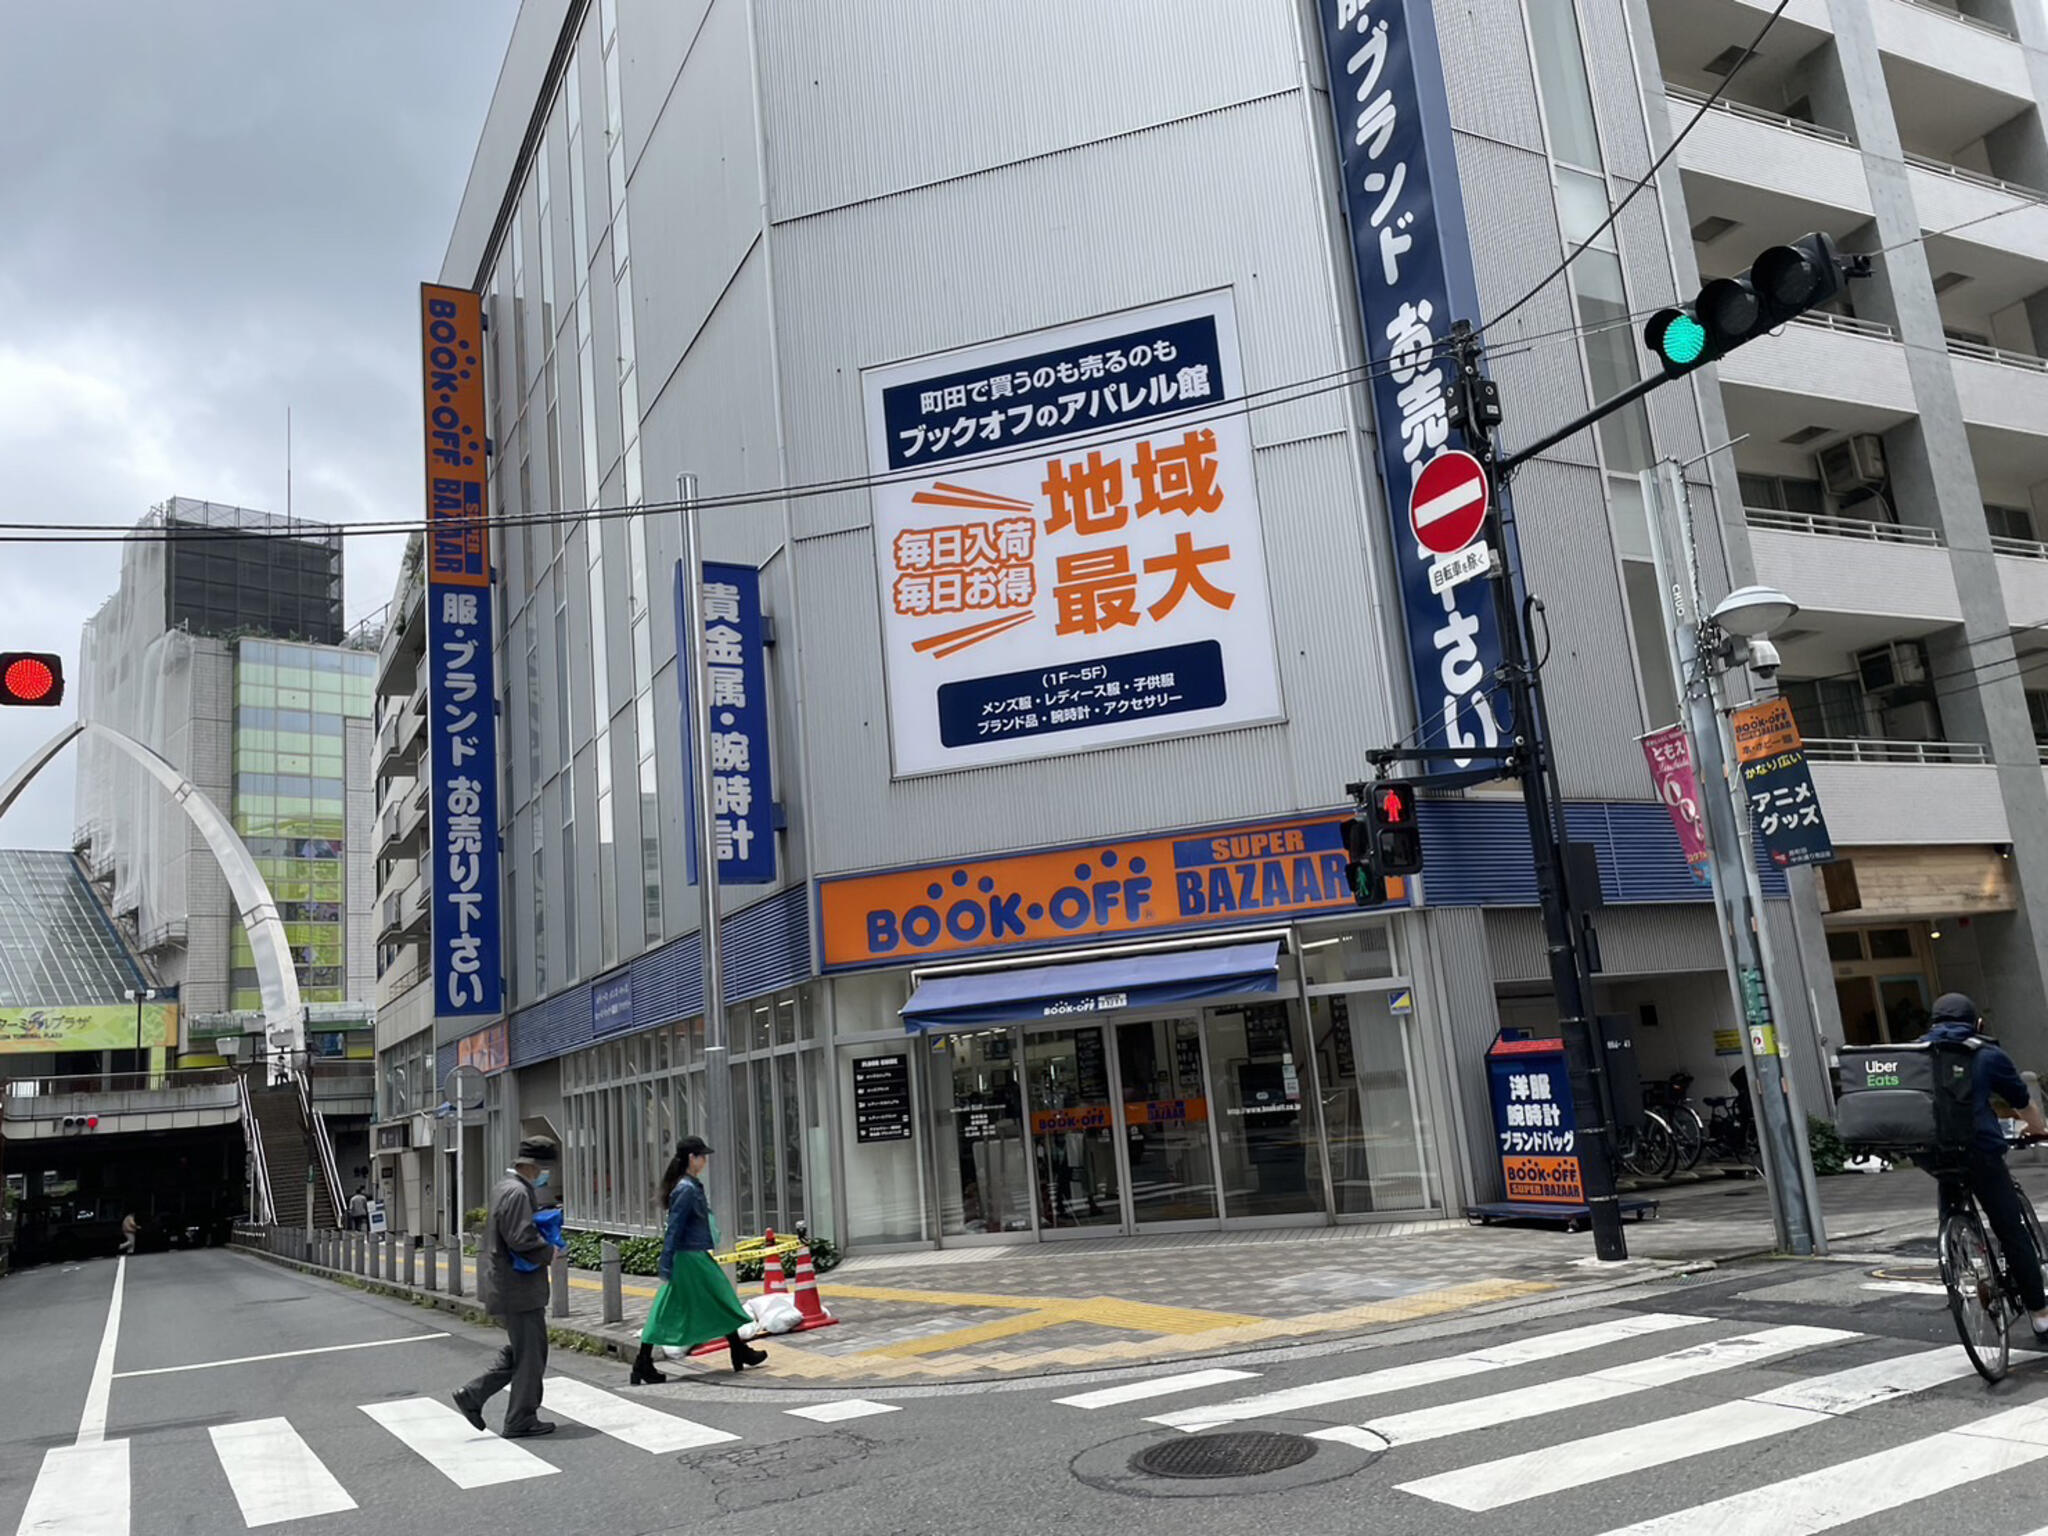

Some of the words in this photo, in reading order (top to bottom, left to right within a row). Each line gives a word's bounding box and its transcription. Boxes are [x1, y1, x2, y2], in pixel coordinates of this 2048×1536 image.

[920, 340, 1177, 415] 町田で買うのも売るのも
[899, 364, 1211, 458] ブックオフのアパレル館
[1041, 427, 1224, 536] 地域
[894, 518, 1036, 572] 毎日入荷
[1386, 298, 1498, 768] お売さい
[894, 563, 1036, 617] 毎日お得
[1053, 531, 1236, 637] 最大
[1434, 551, 1485, 587] 自転車を除く
[1672, 583, 1685, 617] CHUO
[443, 593, 479, 767] 服・ブランド
[981, 672, 1176, 716] メンズ服・レディース服・子供服
[703, 582, 754, 861] 貴金属・腕時計
[976, 693, 1184, 736] ブランド品・腕時計・アクセサリー
[1745, 751, 1803, 779] かなり広い
[1752, 782, 1811, 812] アニメ
[1761, 804, 1819, 835] グッズ
[1210, 829, 1305, 861] SUPER
[447, 776, 483, 1008] お売り下さい
[1176, 852, 1353, 917] BAZAAR
[1509, 1073, 1552, 1101] 洋服
[1865, 1060, 1898, 1074] Uber
[1867, 1074, 1900, 1087] Eats
[1506, 1103, 1561, 1127] 腕時計
[1500, 1130, 1575, 1153] ブランドバッグ
[1543, 1183, 1580, 1198] BAZAAR
